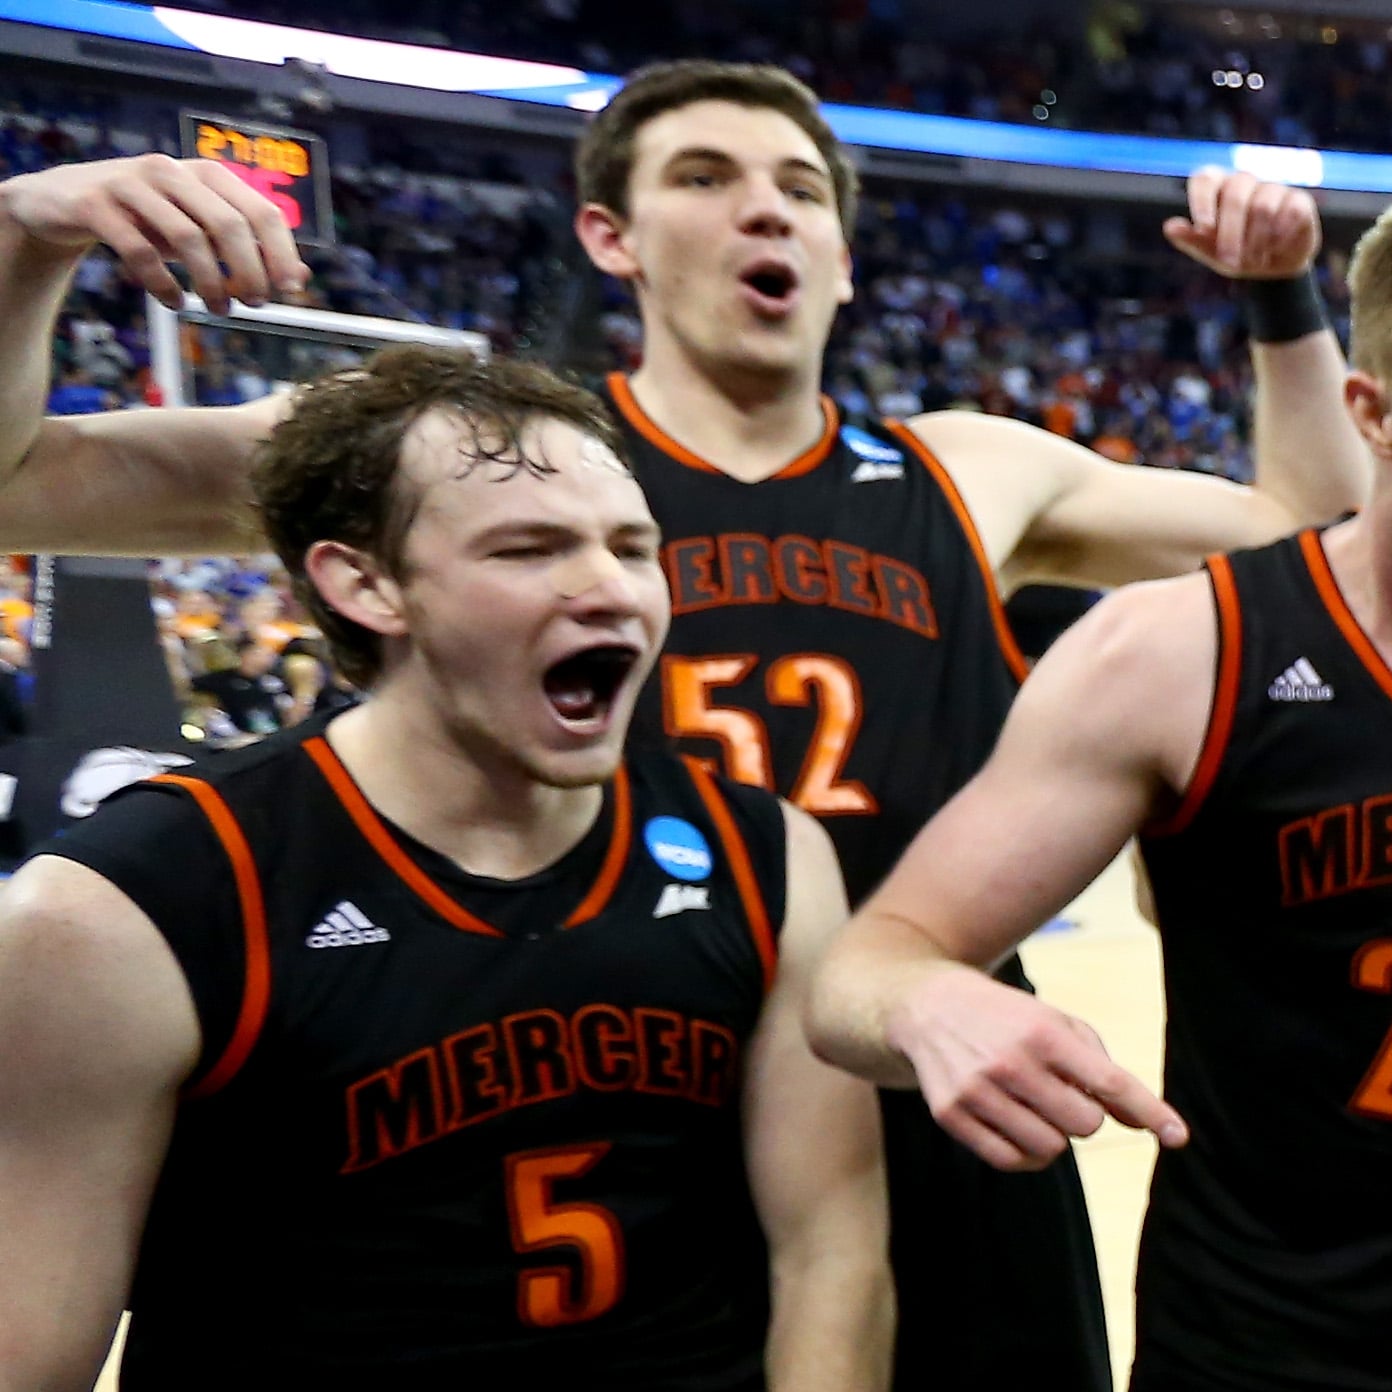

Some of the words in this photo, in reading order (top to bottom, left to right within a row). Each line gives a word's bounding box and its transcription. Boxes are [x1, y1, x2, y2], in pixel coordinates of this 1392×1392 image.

[661, 532, 940, 640] ERCER
[661, 653, 881, 817] 52
[338, 1003, 739, 1175] MERCER
[504, 1141, 626, 1328] 5
